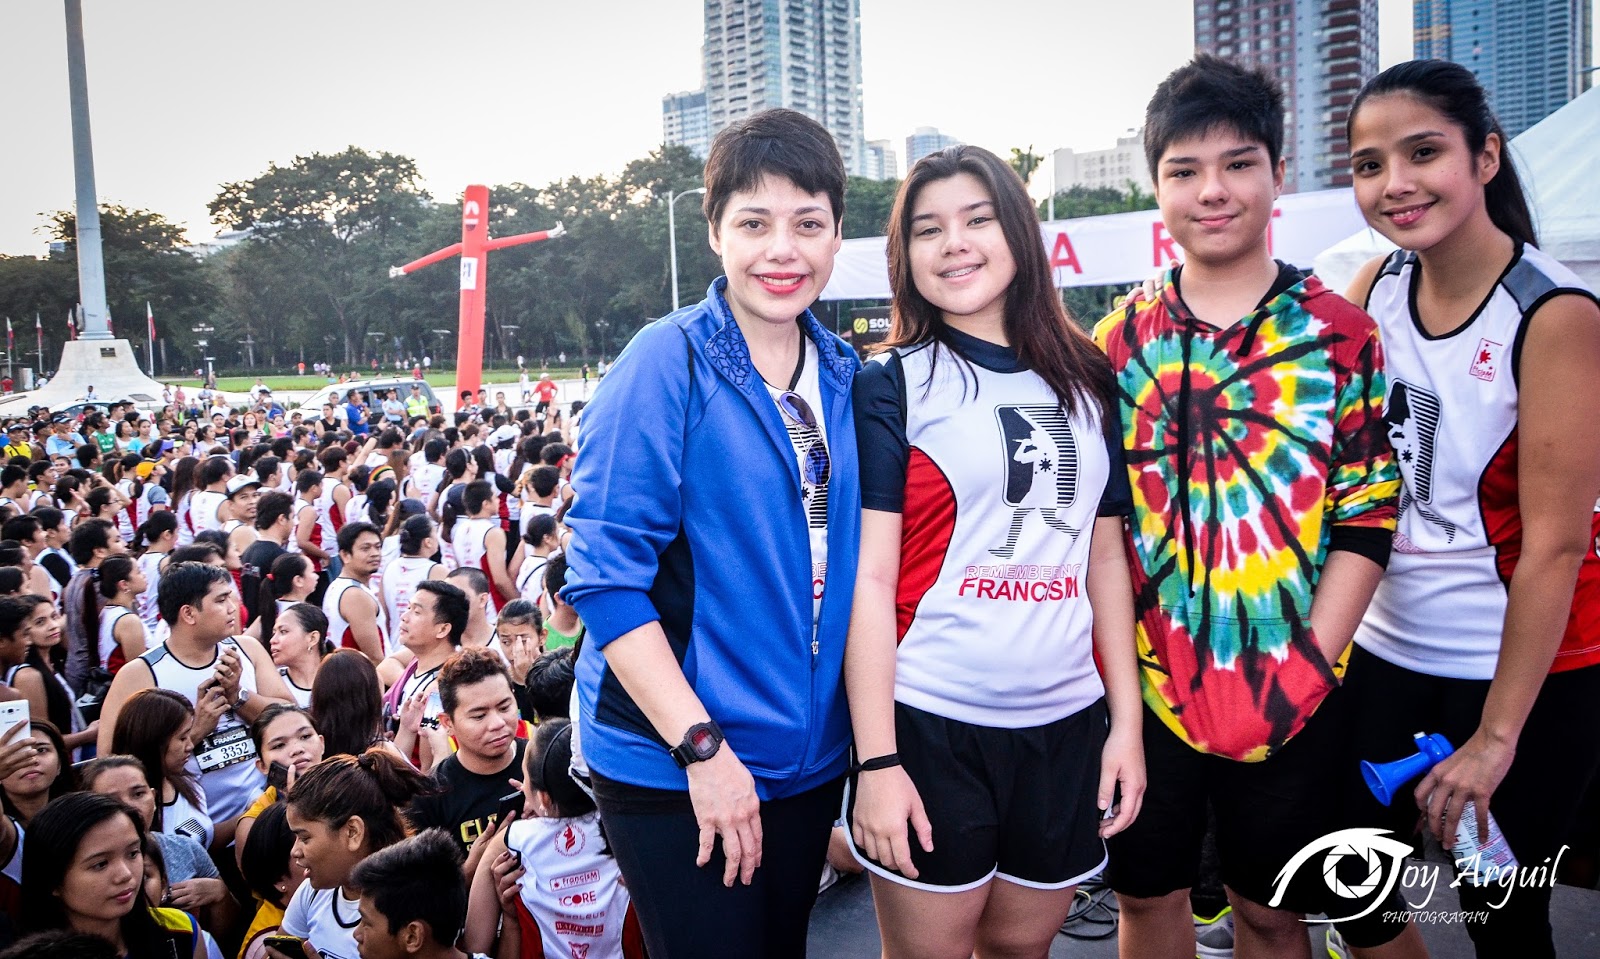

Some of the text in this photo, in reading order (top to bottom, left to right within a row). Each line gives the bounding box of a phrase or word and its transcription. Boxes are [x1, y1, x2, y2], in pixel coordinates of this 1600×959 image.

[868, 317, 892, 329] SOL
[958, 576, 1079, 603] FRANCSM
[220, 741, 249, 760] 3352
[563, 890, 597, 906] CORE
